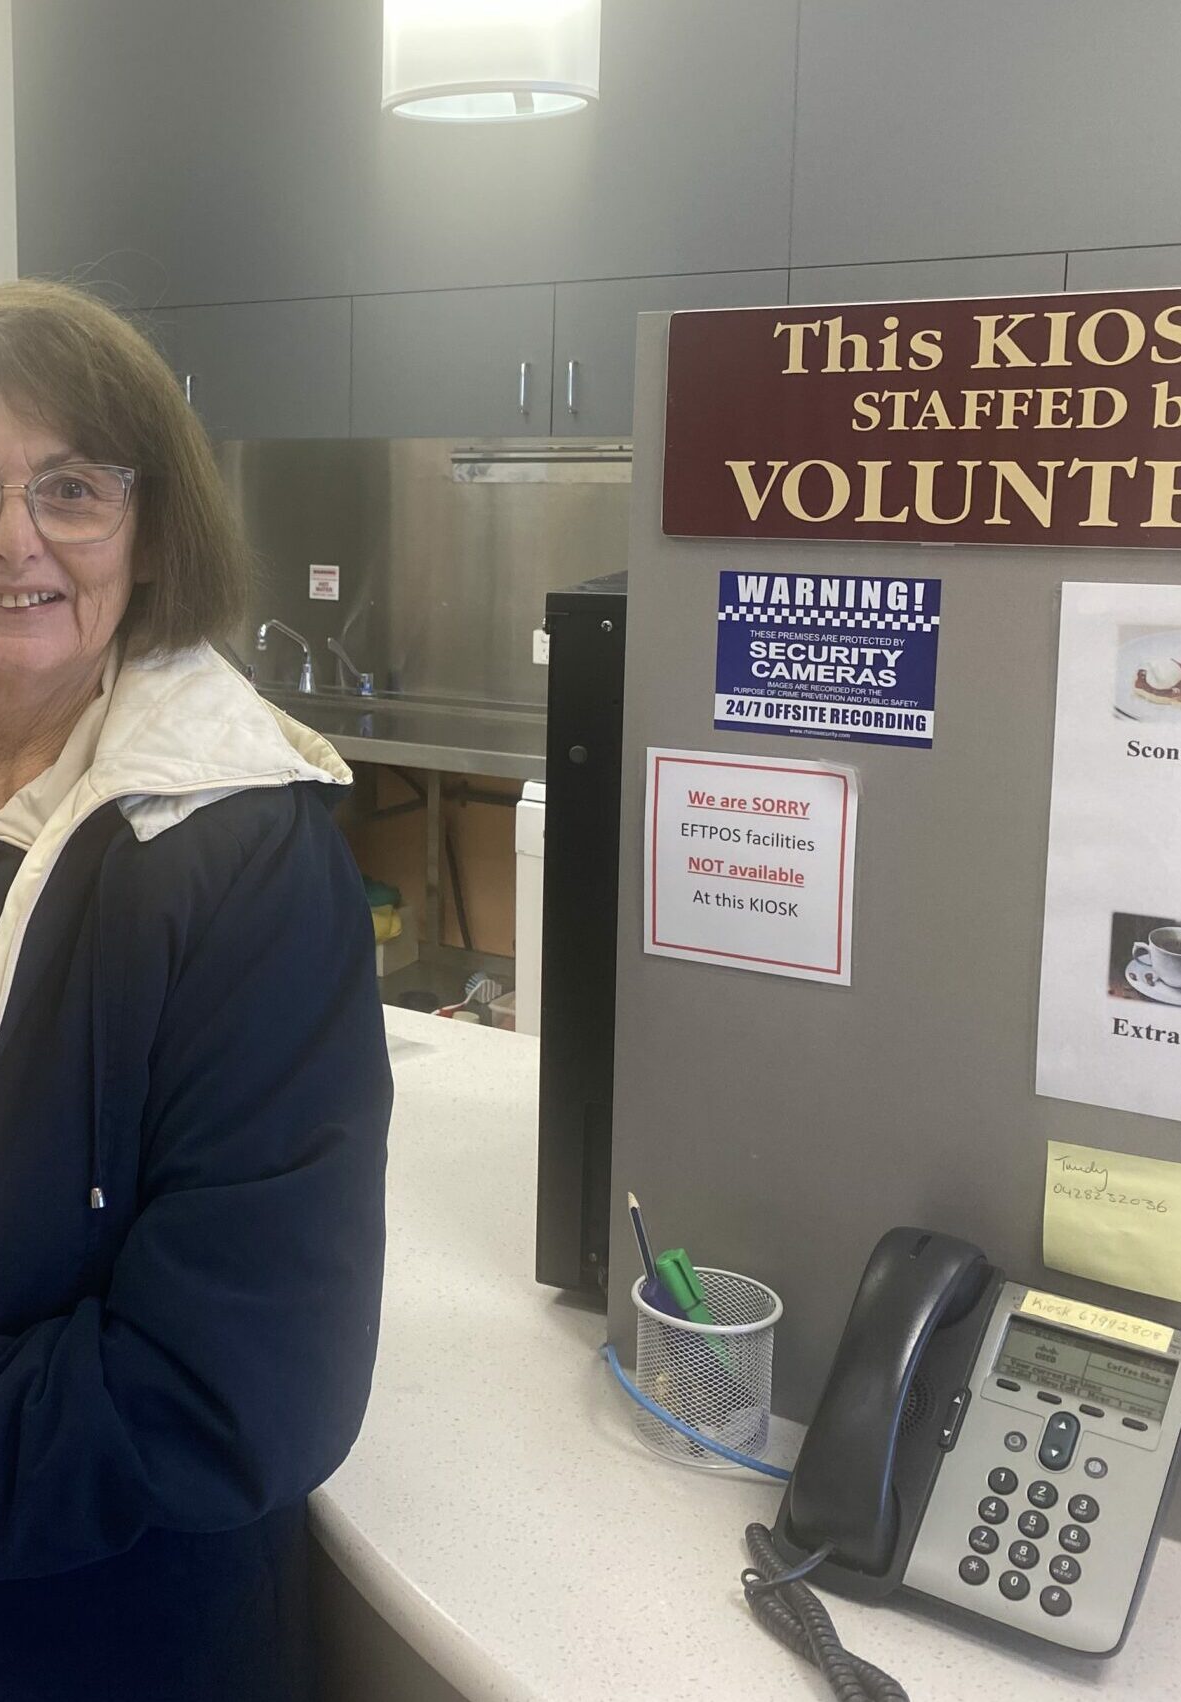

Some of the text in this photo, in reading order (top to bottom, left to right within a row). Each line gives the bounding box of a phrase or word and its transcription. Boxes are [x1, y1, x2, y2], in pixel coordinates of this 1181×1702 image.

[773, 305, 1181, 374] This KIOS
[851, 387, 1128, 431] STAFFED
[724, 456, 1181, 528] VOLUNTE
[737, 575, 925, 611] WARNING!
[750, 630, 905, 646] THESE PREMISES ARE PROTECTED BY
[749, 640, 903, 667] SECURITY
[751, 660, 897, 687] CAMERAS
[733, 687, 766, 696] PURPOSE
[777, 690, 800, 698] CRIME
[801, 692, 845, 702] PREVENTION
[847, 695, 862, 703] AND
[863, 697, 889, 706] PUBLIC
[890, 699, 918, 708] SAFETY
[767, 682, 793, 690] IMAGES
[795, 683, 809, 691] ARE
[811, 684, 850, 694] RECORDED
[869, 689, 882, 697] THE
[726, 699, 926, 732] 24/7 OFFSITE RECORDING
[688, 789, 810, 817] We are SORRY
[681, 822, 815, 852] EFTPOS facilities
[688, 856, 805, 885] NOT available
[693, 890, 798, 918] At this KIOSK
[1111, 1017, 1180, 1045] Extra
[1032, 1297, 1070, 1317] Kiosk
[1000, 1472, 1006, 1482] 1
[1038, 1486, 1047, 1496] 2
[988, 1502, 997, 1511] 4
[1079, 1500, 1088, 1510] 3
[1029, 1515, 1038, 1525] 5
[981, 1530, 988, 1540] 7
[1070, 1530, 1078, 1540] 6
[1020, 1546, 1028, 1555] 8
[1061, 1560, 1069, 1570] 9
[1010, 1576, 1019, 1586] 0
